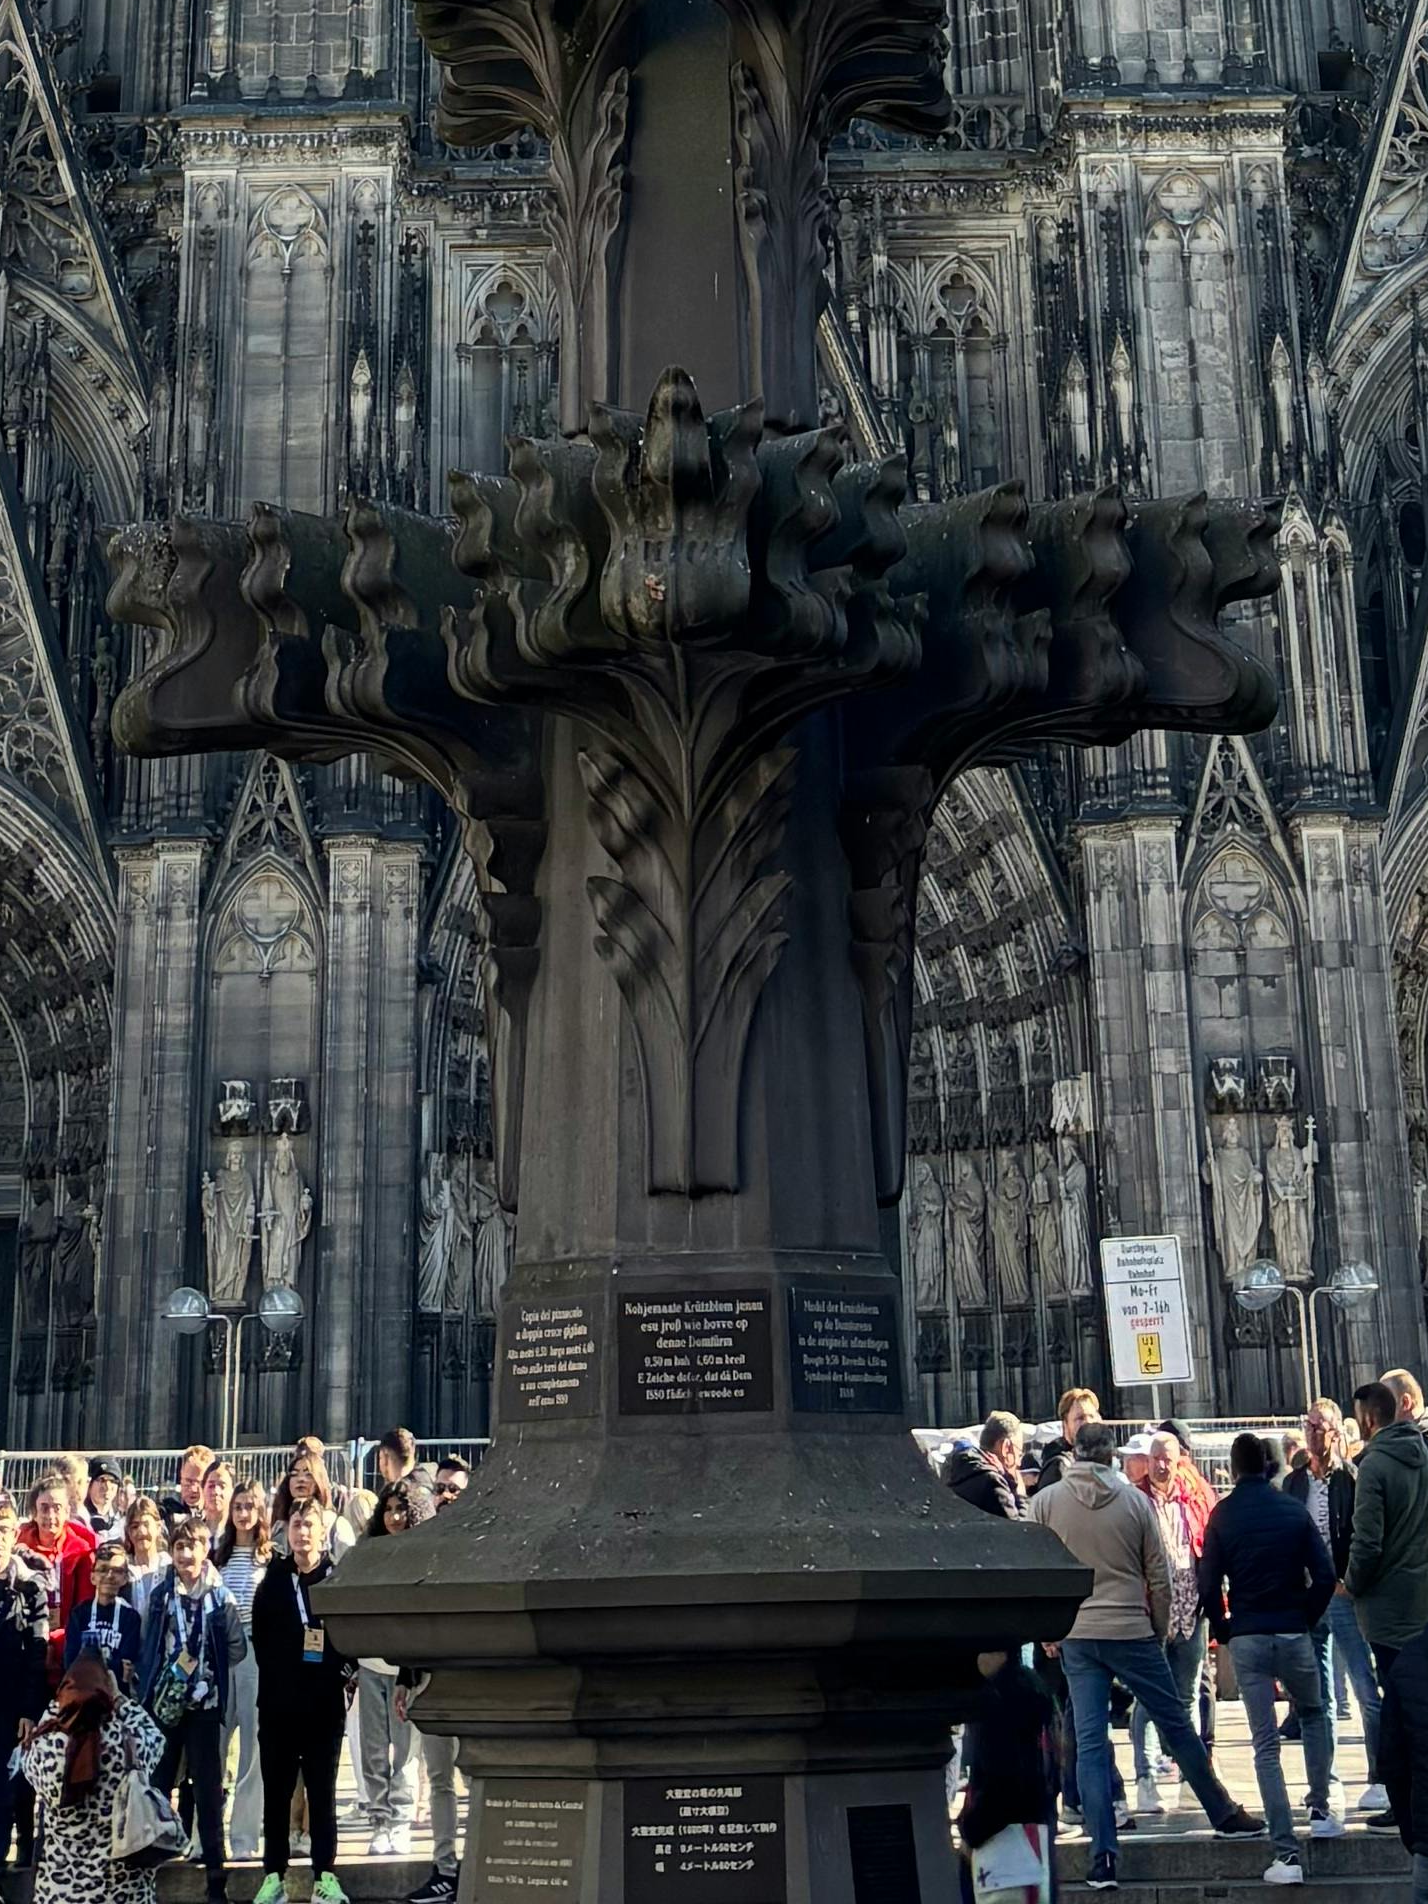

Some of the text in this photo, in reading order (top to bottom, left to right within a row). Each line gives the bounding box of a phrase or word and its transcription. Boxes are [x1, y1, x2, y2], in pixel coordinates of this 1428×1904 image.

[1122, 1305, 1138, 1316] von
[684, 1320, 701, 1330] wie
[735, 1319, 748, 1332] op
[1130, 1316, 1164, 1330] gesperrt
[664, 1358, 672, 1366] m
[715, 1356, 724, 1364] m
[638, 1372, 644, 1384] E
[646, 1371, 675, 1384] Zeiche
[732, 1370, 752, 1381] Dom
